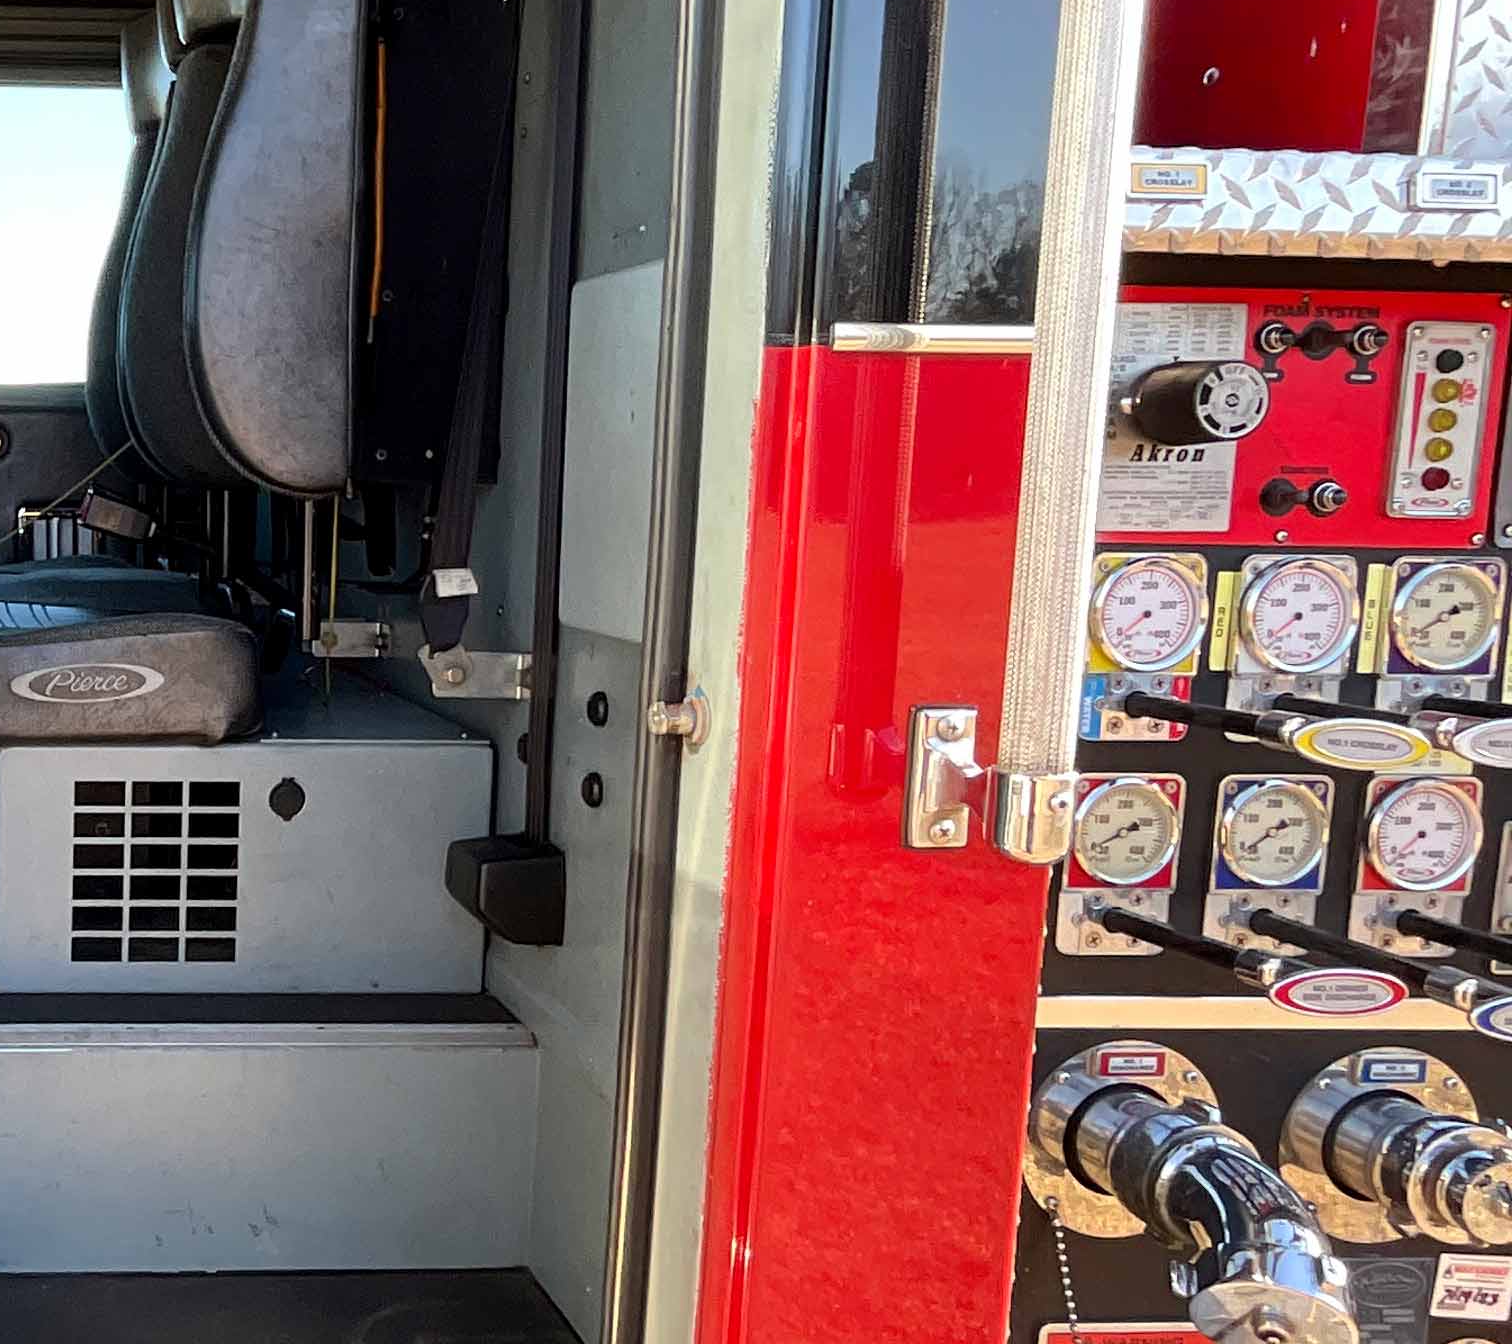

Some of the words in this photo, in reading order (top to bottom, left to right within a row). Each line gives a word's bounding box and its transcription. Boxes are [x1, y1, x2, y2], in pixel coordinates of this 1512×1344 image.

[1263, 304, 1309, 316] FOAM
[1315, 305, 1380, 318] SYSTEM
[1129, 444, 1205, 462] Akron
[1141, 582, 1158, 590] 200
[1292, 584, 1311, 592] 200
[1119, 597, 1136, 605] 100
[1270, 599, 1287, 607] 100
[44, 669, 129, 694] Pierce
